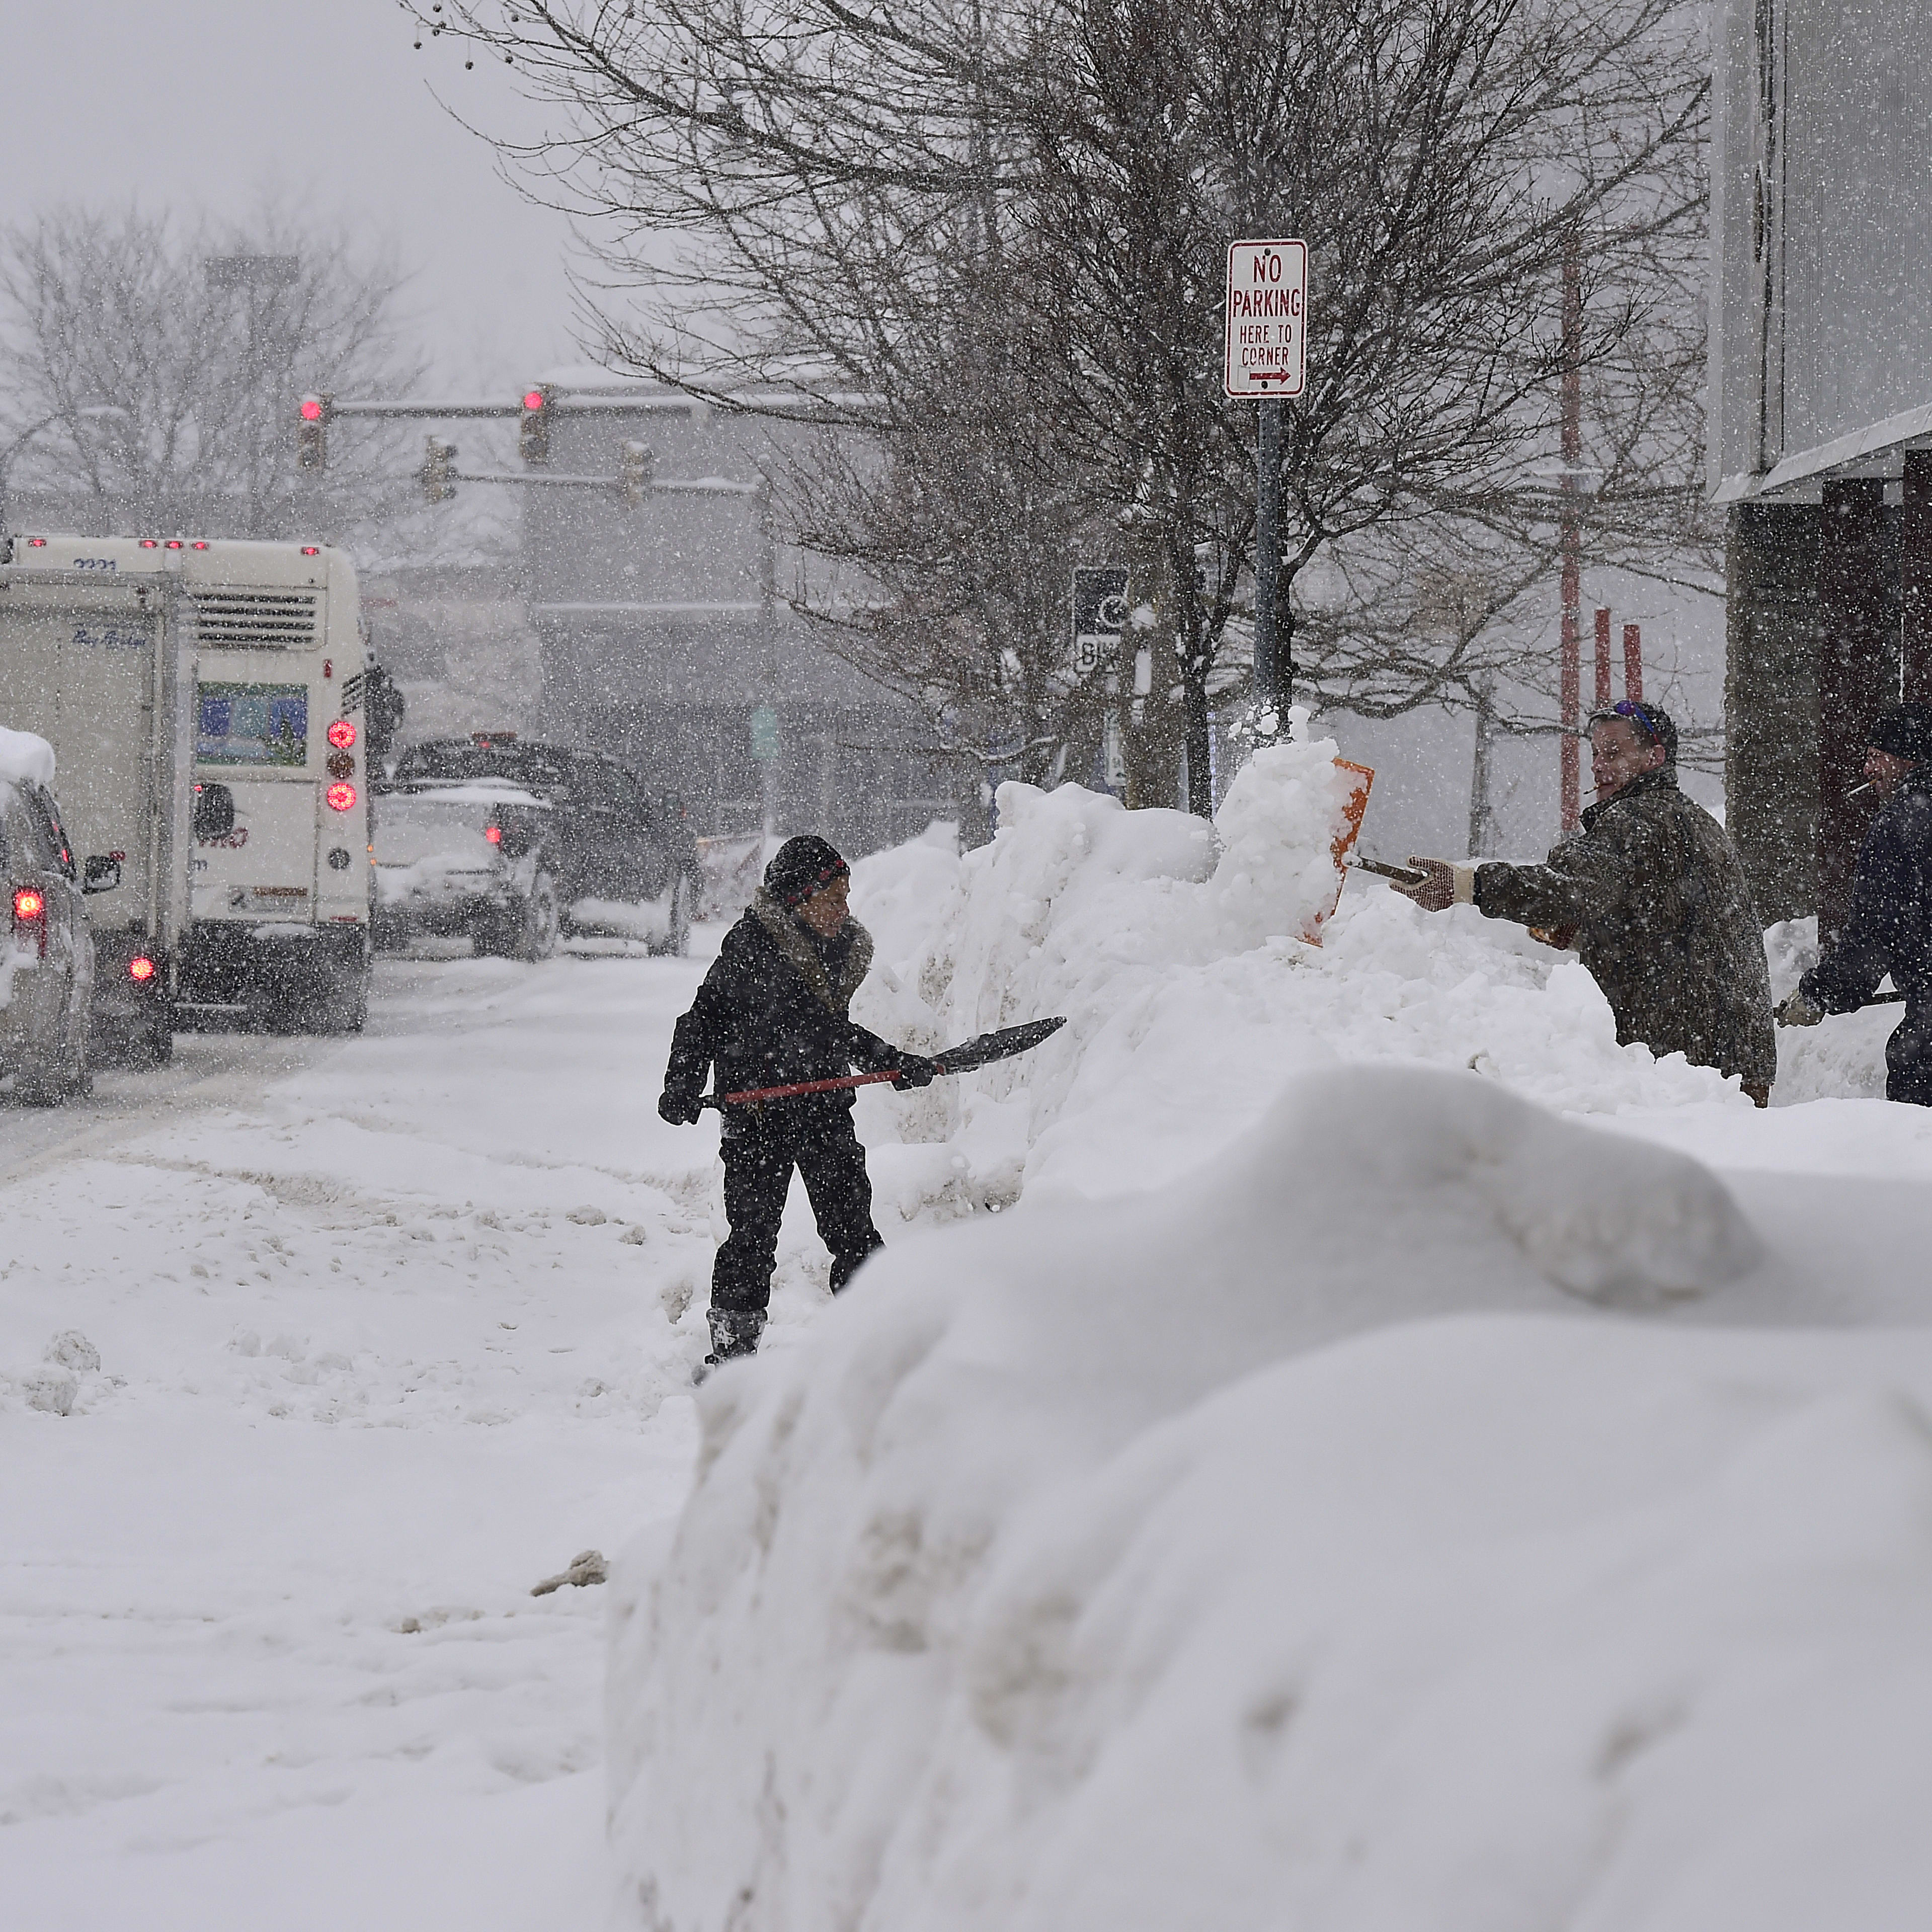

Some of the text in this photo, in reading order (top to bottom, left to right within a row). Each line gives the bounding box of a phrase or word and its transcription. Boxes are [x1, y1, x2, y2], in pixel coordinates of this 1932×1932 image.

[1253, 255, 1282, 283] NO
[1233, 288, 1301, 317] PARKING
[1240, 324, 1292, 344] HERE TO
[1242, 347, 1289, 366] CORNER
